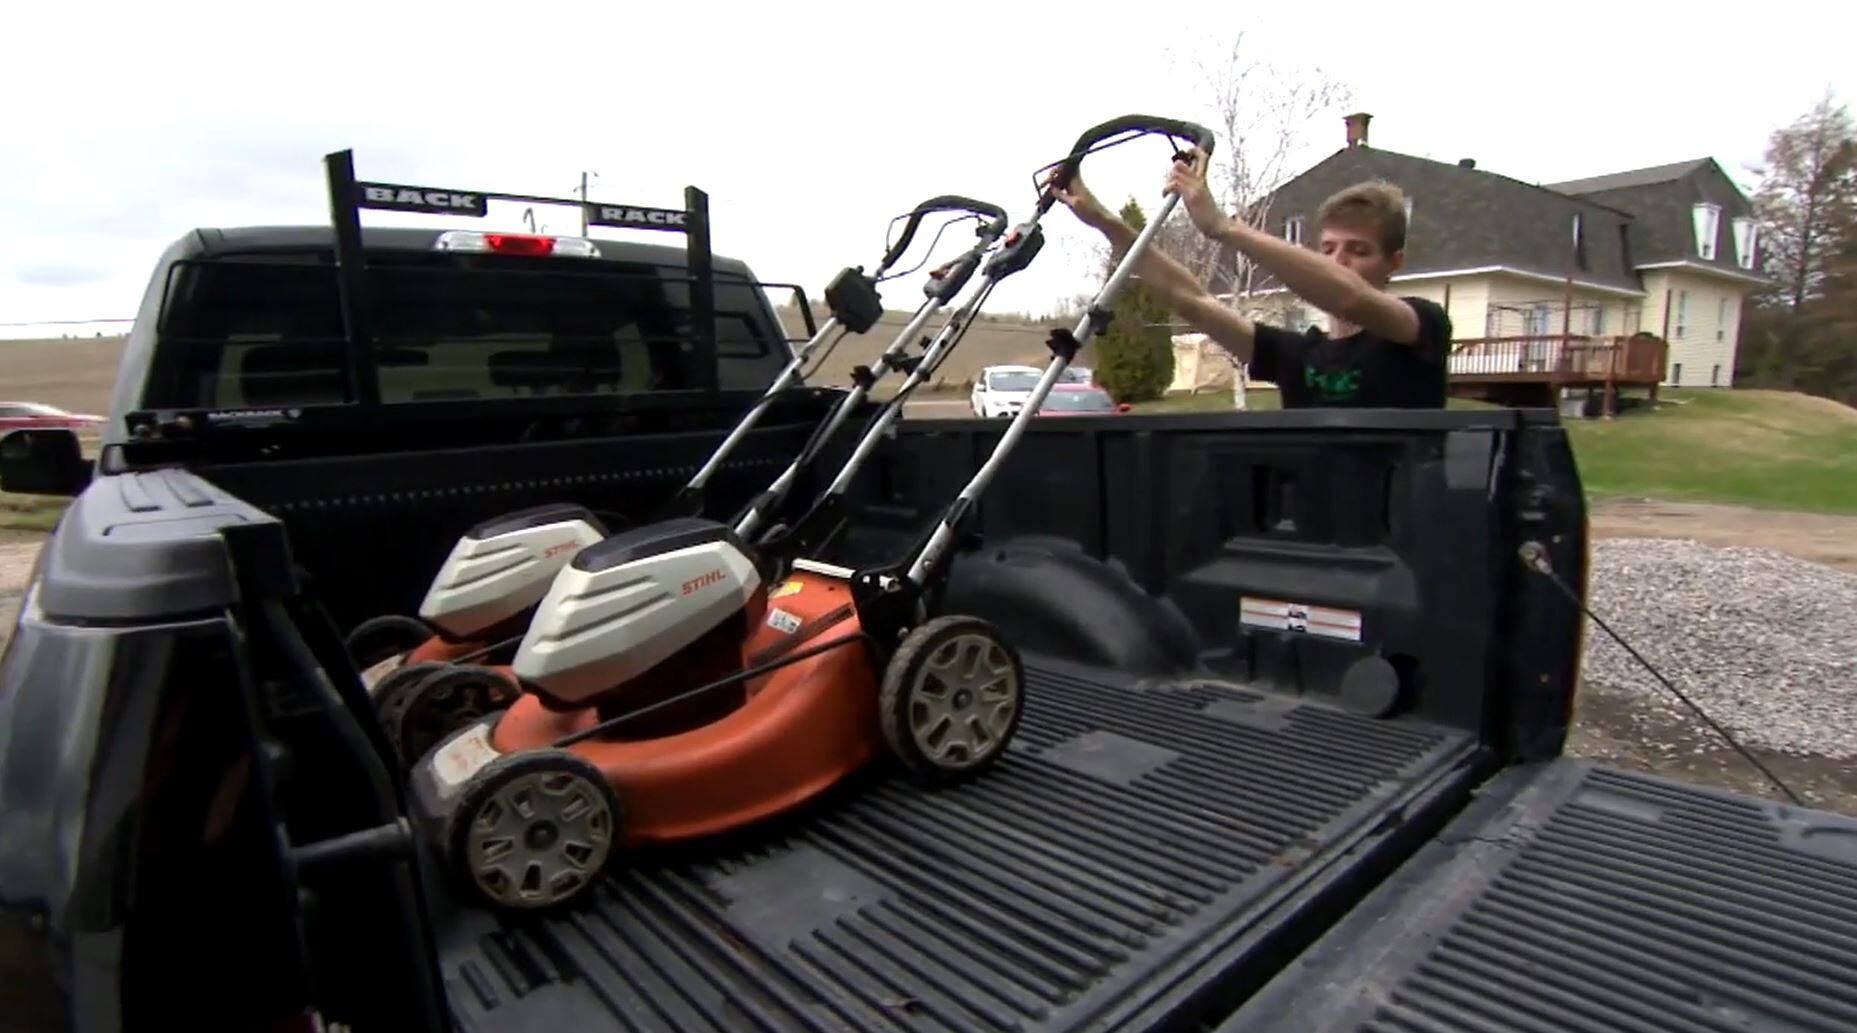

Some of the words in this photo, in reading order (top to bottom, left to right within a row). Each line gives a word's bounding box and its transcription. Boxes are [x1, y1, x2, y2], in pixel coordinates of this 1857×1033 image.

[364, 186, 477, 208] BACK
[601, 205, 687, 226] RACK
[681, 568, 727, 596] STIHL
